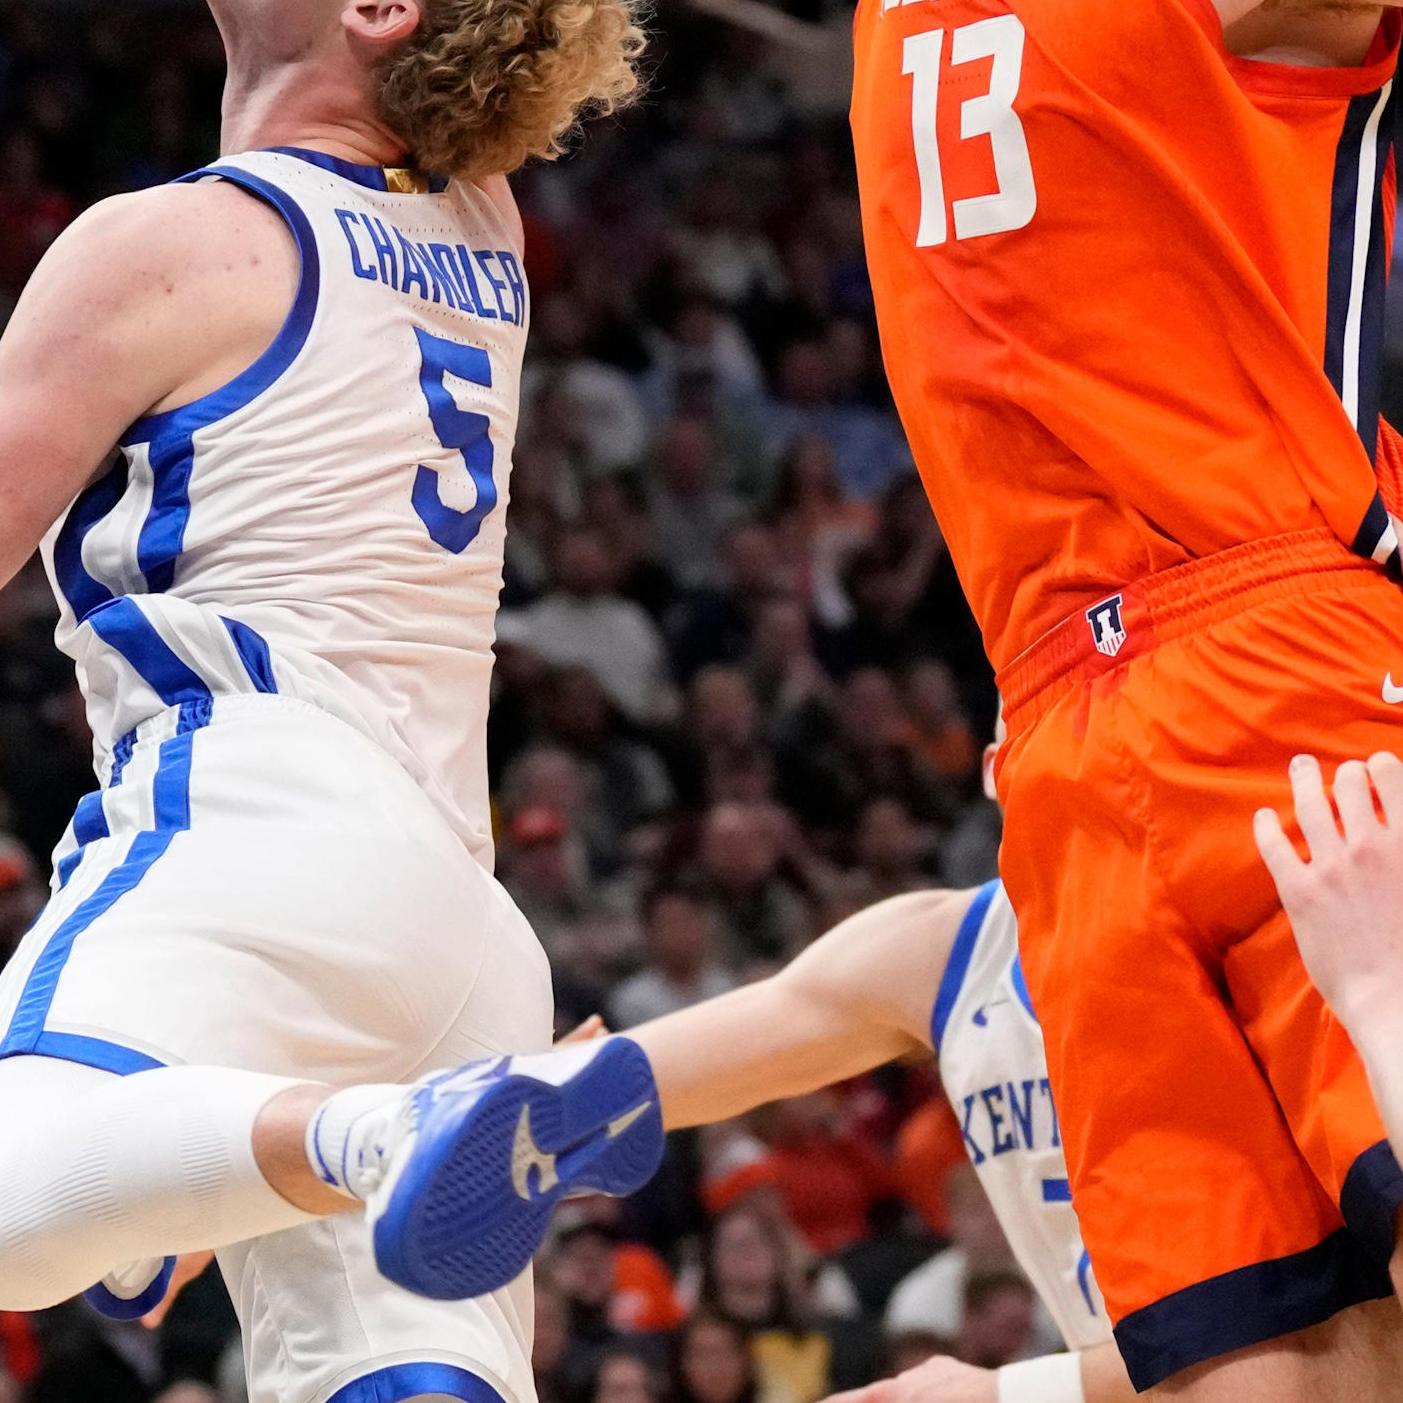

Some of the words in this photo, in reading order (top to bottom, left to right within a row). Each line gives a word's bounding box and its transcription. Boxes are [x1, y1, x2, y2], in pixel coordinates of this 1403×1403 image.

[901, 13, 1038, 248] 13
[334, 207, 526, 328] CHANDLER
[410, 325, 498, 555] 5
